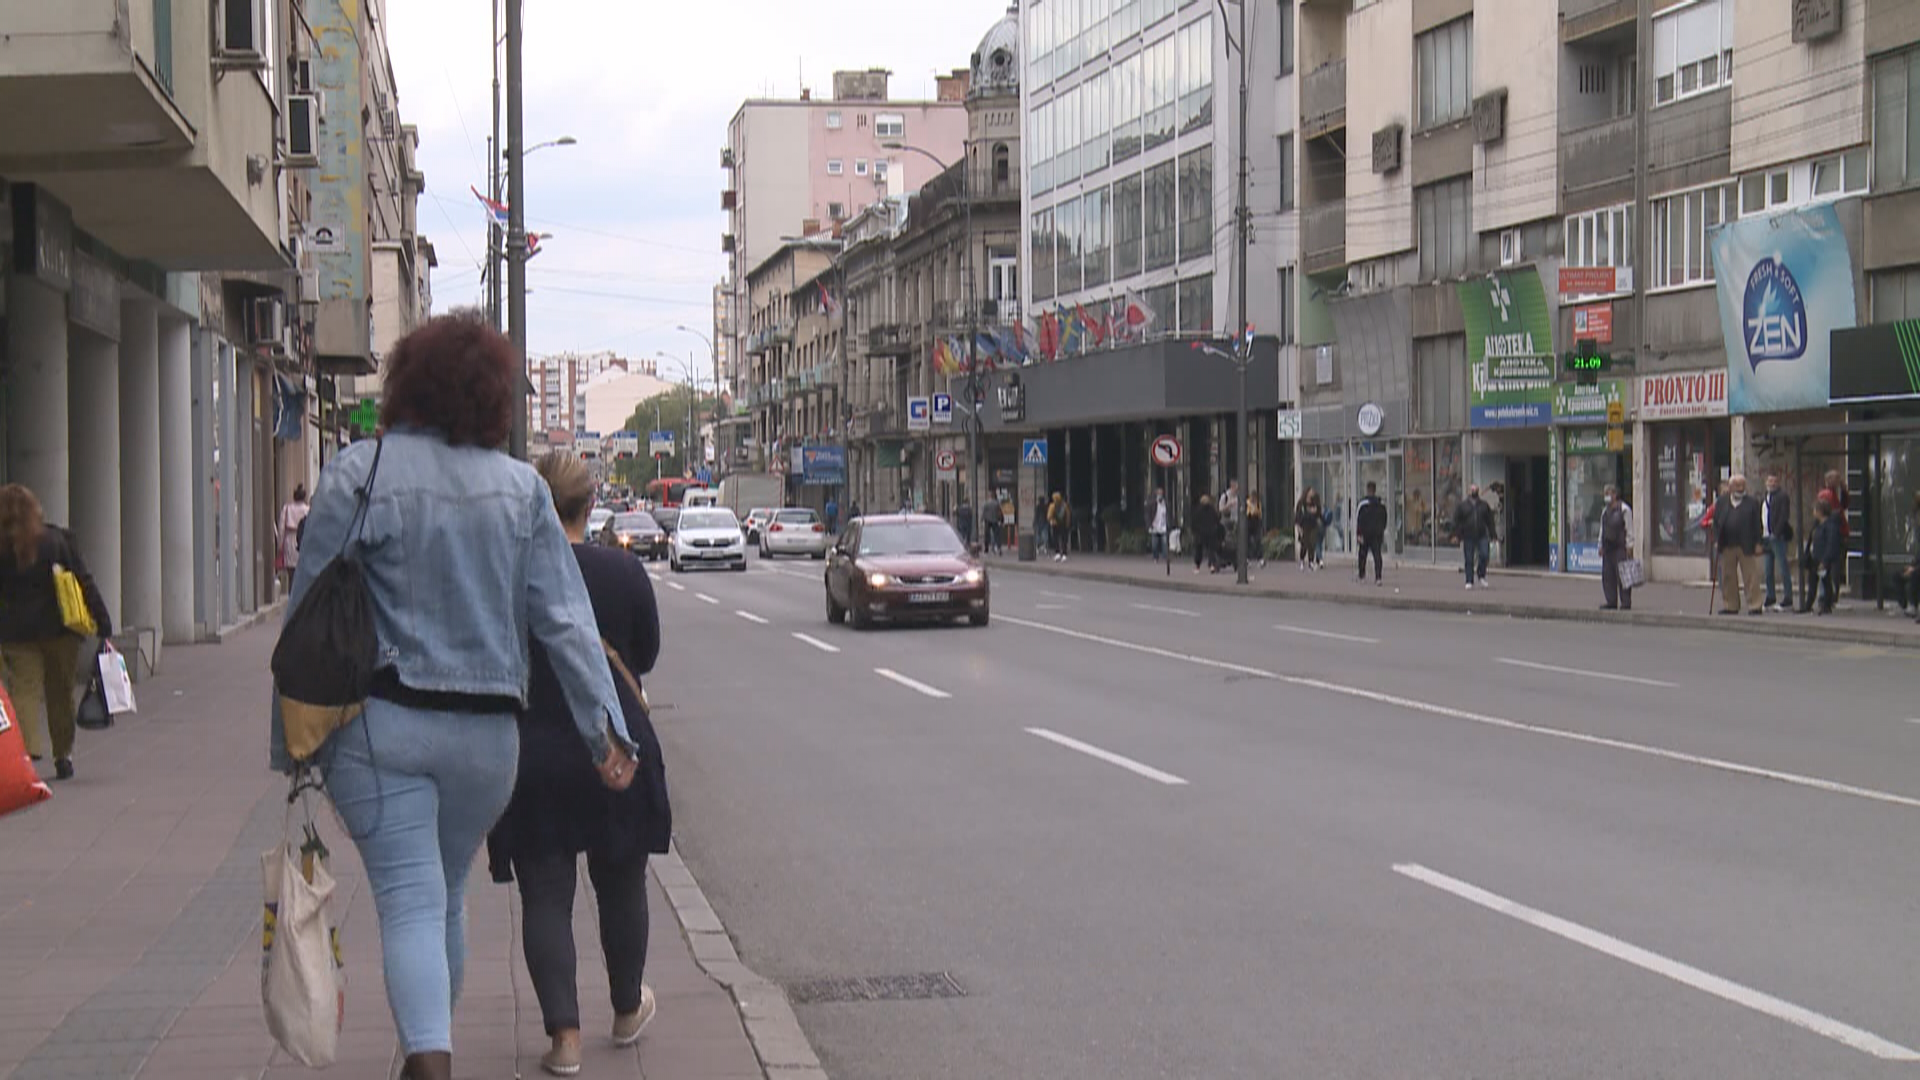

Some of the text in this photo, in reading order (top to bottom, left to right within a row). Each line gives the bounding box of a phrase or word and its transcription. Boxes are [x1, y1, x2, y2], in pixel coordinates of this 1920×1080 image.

[1750, 262, 1772, 292] FRESH
[1781, 269, 1800, 304] SOFT
[1748, 312, 1801, 355] ZEN
[1574, 356, 1602, 369] 21.09
[937, 397, 950, 410] P
[1644, 372, 1724, 407] PRONTO III
